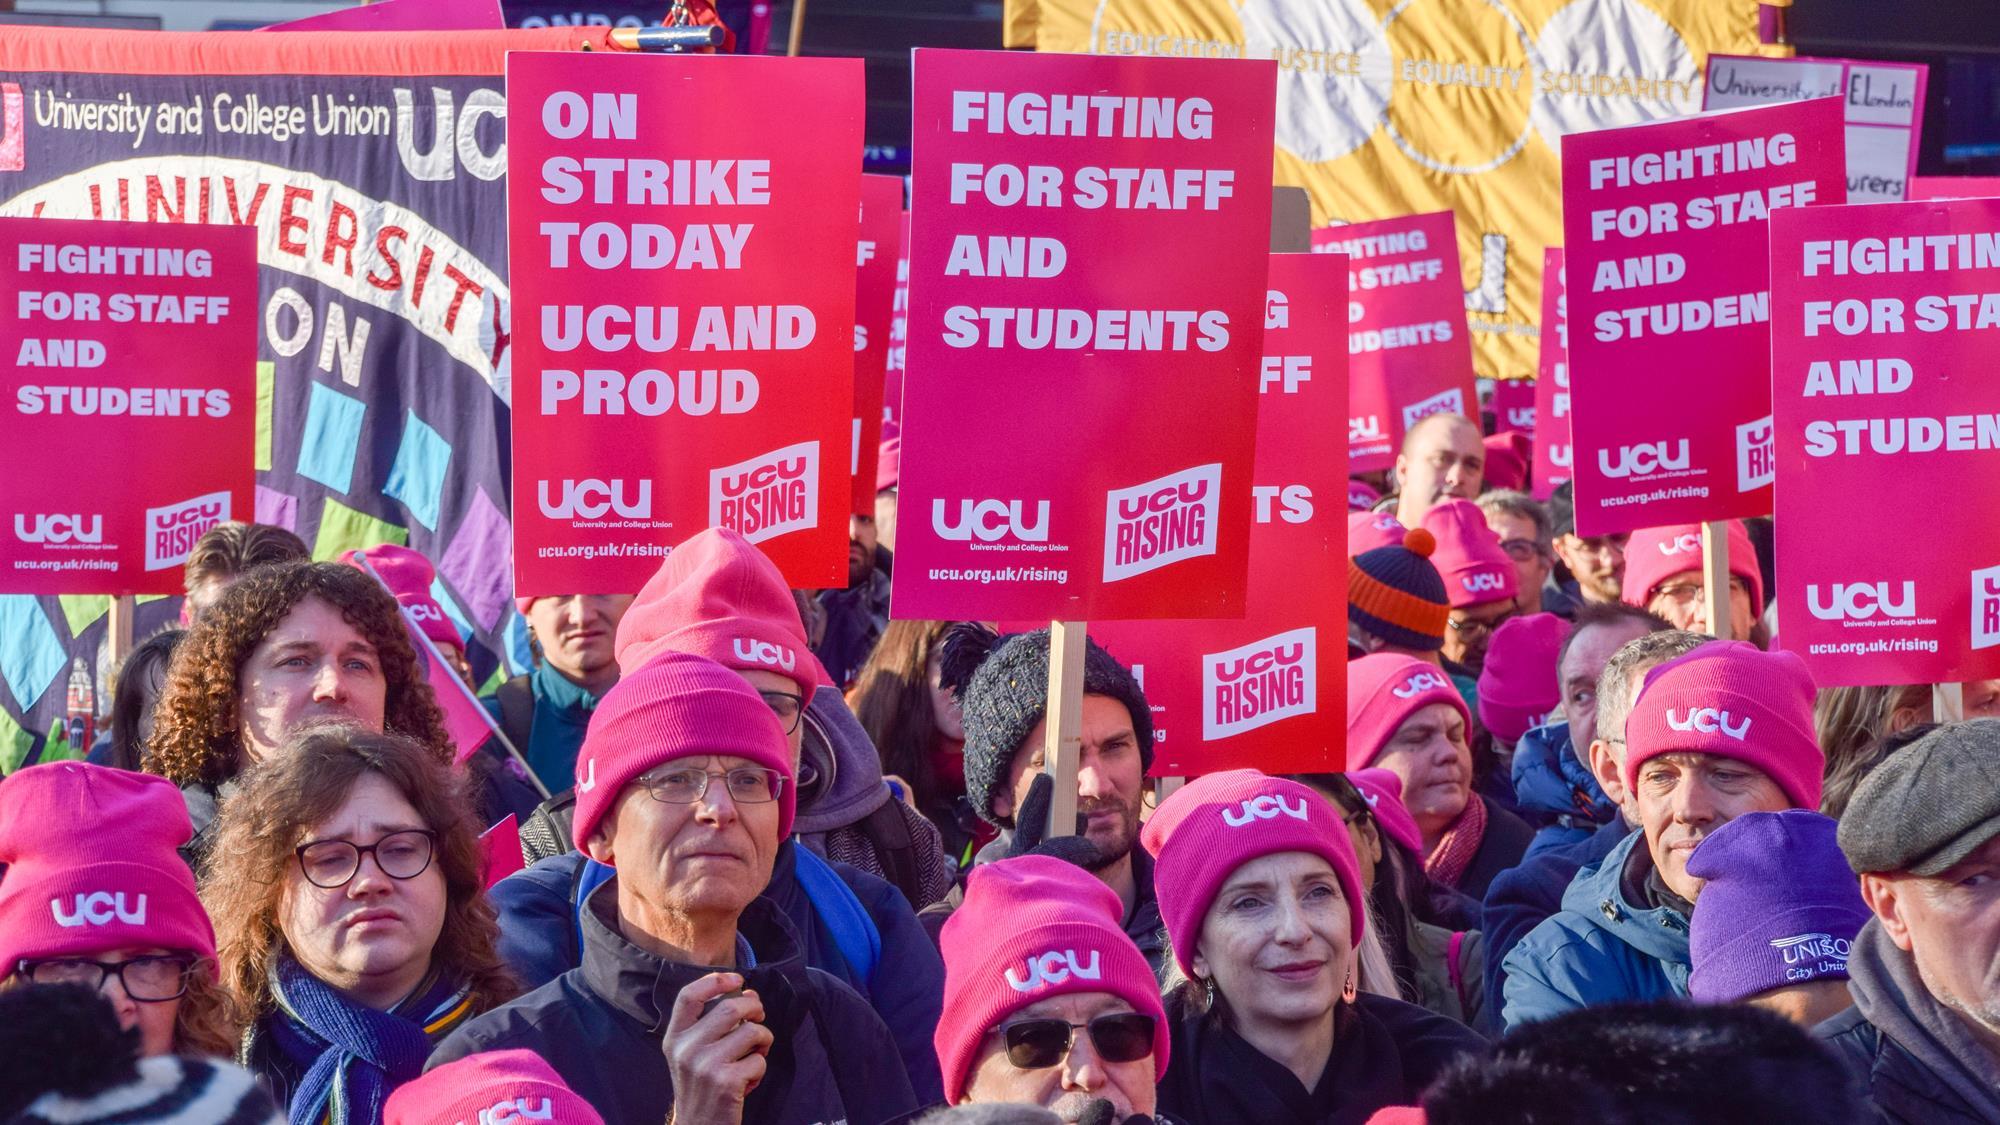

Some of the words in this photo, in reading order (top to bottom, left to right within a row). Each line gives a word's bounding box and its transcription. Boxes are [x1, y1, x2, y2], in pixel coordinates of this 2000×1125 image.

[1402, 59, 1523, 92] EQUALITY
[1541, 72, 1693, 101] SOLIDARITY
[1711, 65, 1813, 99] University
[34, 89, 151, 149] University
[156, 94, 202, 135] and
[213, 93, 305, 142] College
[312, 93, 390, 137] Union
[394, 86, 509, 181] UC
[542, 92, 637, 139] ON
[953, 91, 1212, 139] FIGHTING
[1590, 133, 1796, 190] FIGHTING
[541, 157, 770, 205] STRIKE
[951, 163, 1063, 206] FOR
[1074, 167, 1234, 210] STAFF
[1845, 174, 1902, 197] urers
[1592, 203, 1677, 240] FOR
[1686, 181, 1816, 227] STAFF
[19, 244, 211, 276] FIGHTING
[540, 222, 754, 269] TODAY
[945, 235, 1066, 277] AND
[1313, 230, 1428, 259] HTING
[1804, 233, 2000, 276] FIGHTIN
[1359, 258, 1442, 290] STAFF
[1593, 254, 1685, 291] AND
[19, 292, 100, 320] FOR
[109, 294, 228, 323] STAFF
[1593, 292, 1768, 341] STUDEN
[1805, 299, 1904, 336] FOR
[1915, 294, 2000, 331] STA
[542, 305, 678, 352] UCU
[690, 306, 816, 351] AND
[943, 306, 1229, 351] STUDENTS
[1348, 321, 1452, 353] UDENTS
[17, 339, 106, 367] AND
[542, 370, 759, 416] PROUD
[1804, 359, 1913, 396] AND
[17, 386, 230, 417] STUDENTS
[1508, 407, 1536, 426] UC
[1805, 414, 2000, 456] STUDEN
[721, 457, 806, 497] UCU
[1598, 439, 1689, 478] UCU
[538, 479, 651, 519] UCU
[720, 480, 806, 538] RISING
[1119, 480, 1207, 520] UCU
[1601, 486, 1709, 507] ucu.org.uk/rising
[15, 514, 102, 543] UCU
[156, 503, 221, 528] UCU
[572, 521, 607, 530] University
[624, 521, 650, 530] College
[652, 520, 673, 528] Union
[932, 499, 1050, 541] UCU
[539, 543, 673, 559] ucu.org.uk/rising
[970, 544, 1005, 552] University
[1021, 544, 1047, 552] College
[1116, 504, 1205, 565] RISING
[14, 560, 118, 571] ucu.org.uk/rising
[929, 567, 1067, 584] ucu.org.uk/rising
[1462, 573, 1504, 592] UCU
[1807, 581, 1916, 620] UCU
[733, 638, 795, 672] UCU
[1216, 643, 1303, 682] UCU
[1810, 637, 1938, 655] ucu.org.uk/rising
[1216, 666, 1303, 725] RISING
[1393, 672, 1448, 699] UCU
[1666, 707, 1752, 740] UCU
[1222, 795, 1307, 827] UCU
[51, 891, 146, 927] UCU
[1004, 949, 1100, 992] UCU
[1786, 967, 1813, 980] City
[456, 1097, 552, 1125] CU
